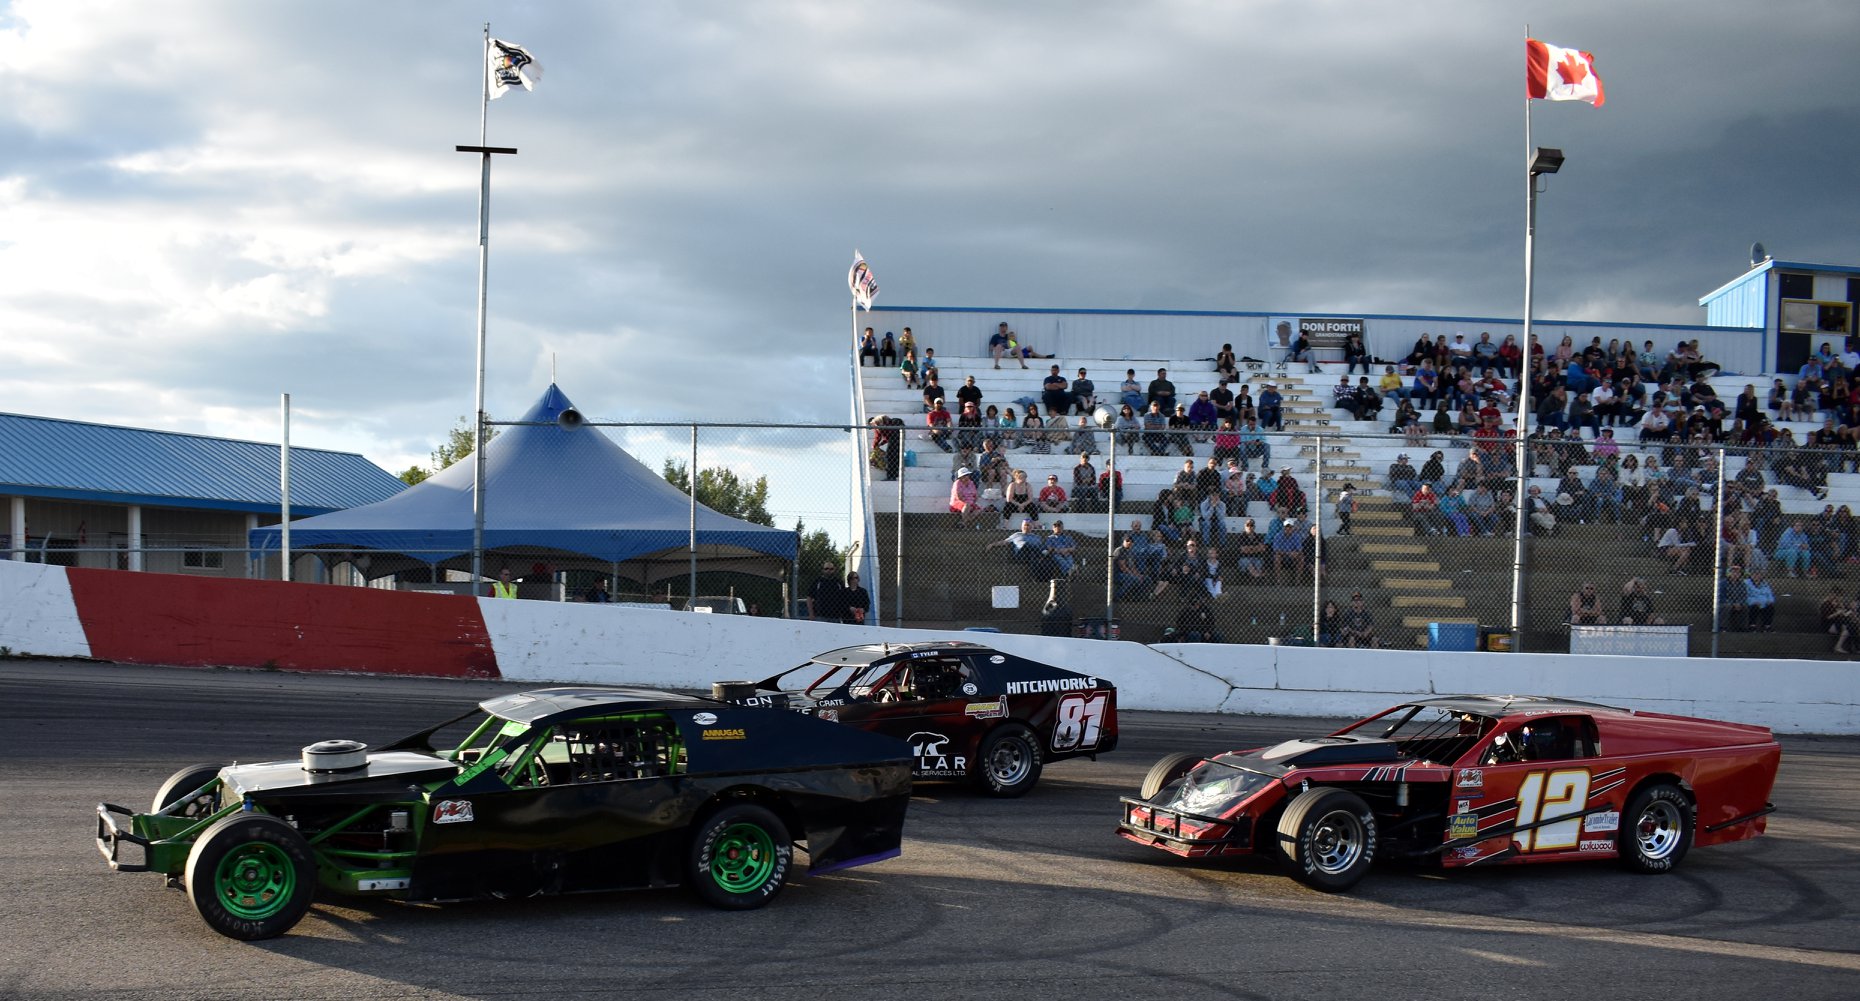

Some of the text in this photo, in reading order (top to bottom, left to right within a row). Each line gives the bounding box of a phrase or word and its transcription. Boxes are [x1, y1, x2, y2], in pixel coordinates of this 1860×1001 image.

[1302, 322, 1360, 332] DON FORTH
[1276, 362, 1287, 370] 20
[1006, 677, 1098, 694] HITCHWORKS
[820, 698, 844, 707] CRATE
[1053, 693, 1108, 750] 81
[703, 729, 745, 737] ANNUGAS
[1512, 769, 1591, 853] 12
[1454, 816, 1475, 825] Auto
[1452, 825, 1475, 834] Value
[1580, 840, 1613, 851] wilwood
[761, 844, 791, 897] Hoosier
